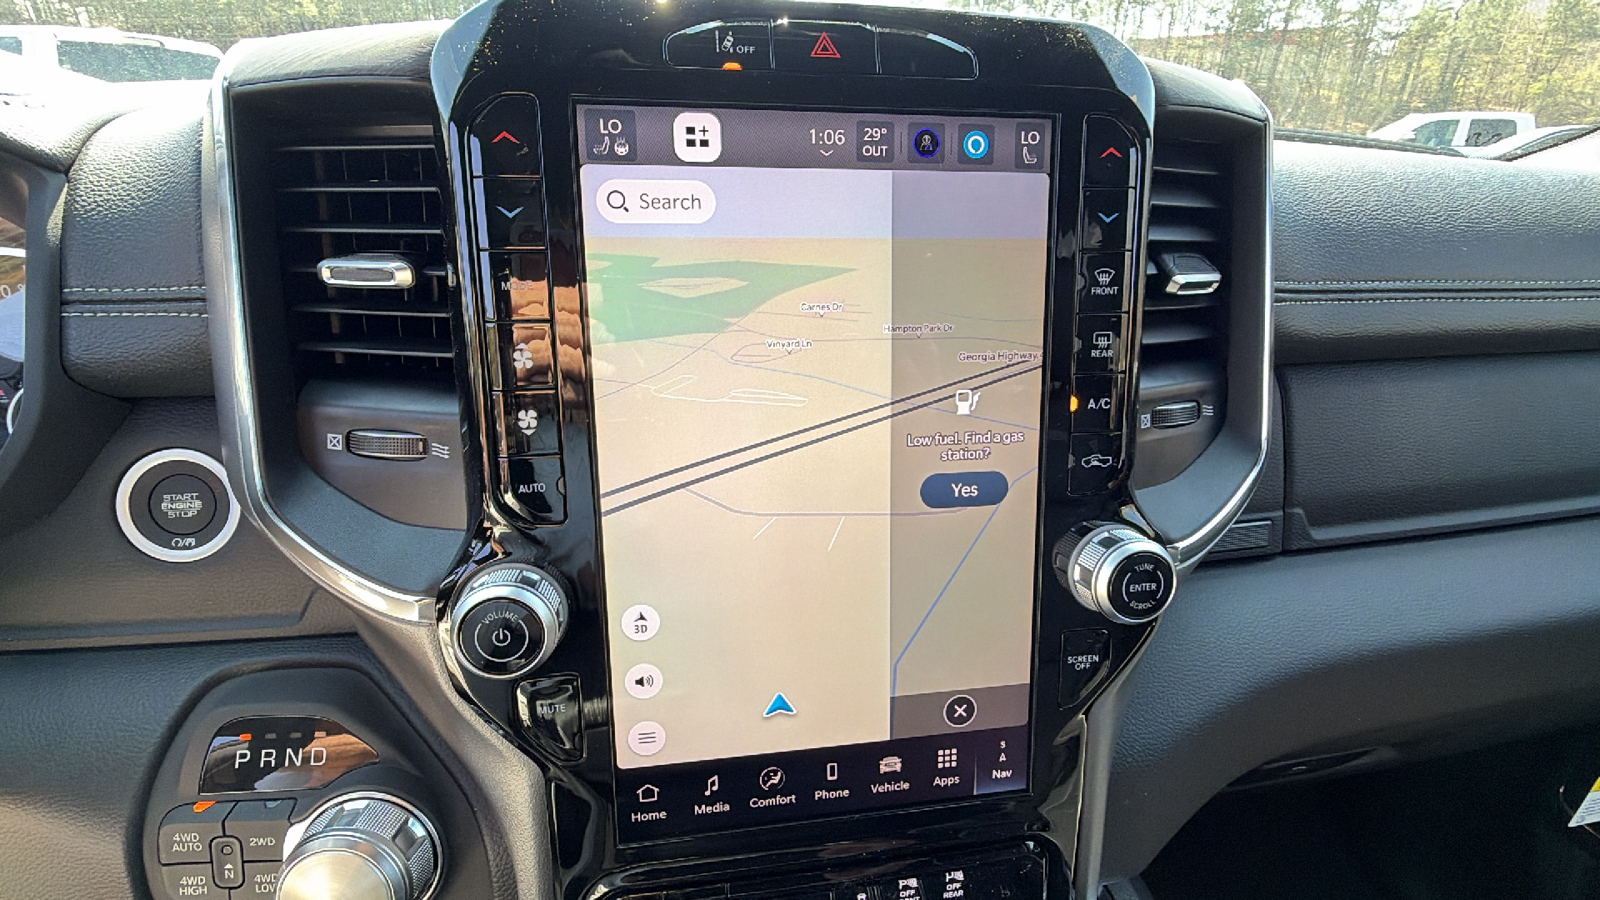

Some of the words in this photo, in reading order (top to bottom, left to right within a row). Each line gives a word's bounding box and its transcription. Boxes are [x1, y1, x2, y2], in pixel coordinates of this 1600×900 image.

[736, 45, 756, 54] OFF
[600, 118, 622, 134] LO
[809, 128, 846, 145] 1:06
[1021, 131, 1041, 144] LO
[862, 145, 888, 156] OUT
[639, 193, 702, 210] Search
[501, 281, 533, 291] MODE
[1091, 286, 1119, 295] FRONT
[832, 302, 843, 312] Dr
[883, 324, 922, 335] Hampton
[924, 324, 942, 333] Park
[943, 324, 954, 333] Dr
[767, 339, 800, 350] Vinyard
[801, 340, 812, 348] Ln
[958, 352, 996, 362] Georgia
[1091, 349, 1114, 358] REAR
[1087, 398, 1111, 410] A/C
[907, 433, 933, 447] Low
[934, 431, 962, 445] fuel.
[964, 430, 991, 444] Find
[993, 433, 1001, 443] a
[1003, 432, 1025, 445] gas
[941, 447, 991, 461] station?
[518, 482, 546, 494] AUTO
[951, 483, 979, 498] Yes
[163, 493, 199, 502] START
[161, 501, 203, 510] ENGINE
[167, 510, 198, 519] STOP
[1134, 563, 1156, 573] TUNE
[1129, 582, 1158, 593] ENTER
[1129, 599, 1157, 611] SCROLL
[481, 609, 519, 625] VOLUME
[634, 624, 648, 634] 3D
[1067, 654, 1099, 664] SCREEN
[1074, 662, 1091, 671] OFF
[537, 703, 566, 714] MUTE
[1000, 740, 1006, 749] S
[999, 752, 1007, 762] A
[991, 769, 1013, 779] Nav
[870, 780, 911, 794] Vehicle
[932, 776, 961, 788] Apps
[814, 788, 850, 801] Phone
[749, 794, 797, 809] Comfort
[694, 801, 730, 816] Media
[631, 809, 668, 823] Home
[172, 832, 200, 842] 4WD
[249, 837, 276, 847] 2WD
[171, 842, 203, 852] AUTO
[224, 869, 234, 879] N
[179, 876, 206, 886] 4WD
[179, 886, 208, 896] HIGH
[945, 882, 962, 891] OFF
[900, 889, 916, 898] OFF
[942, 889, 964, 899] REAR
